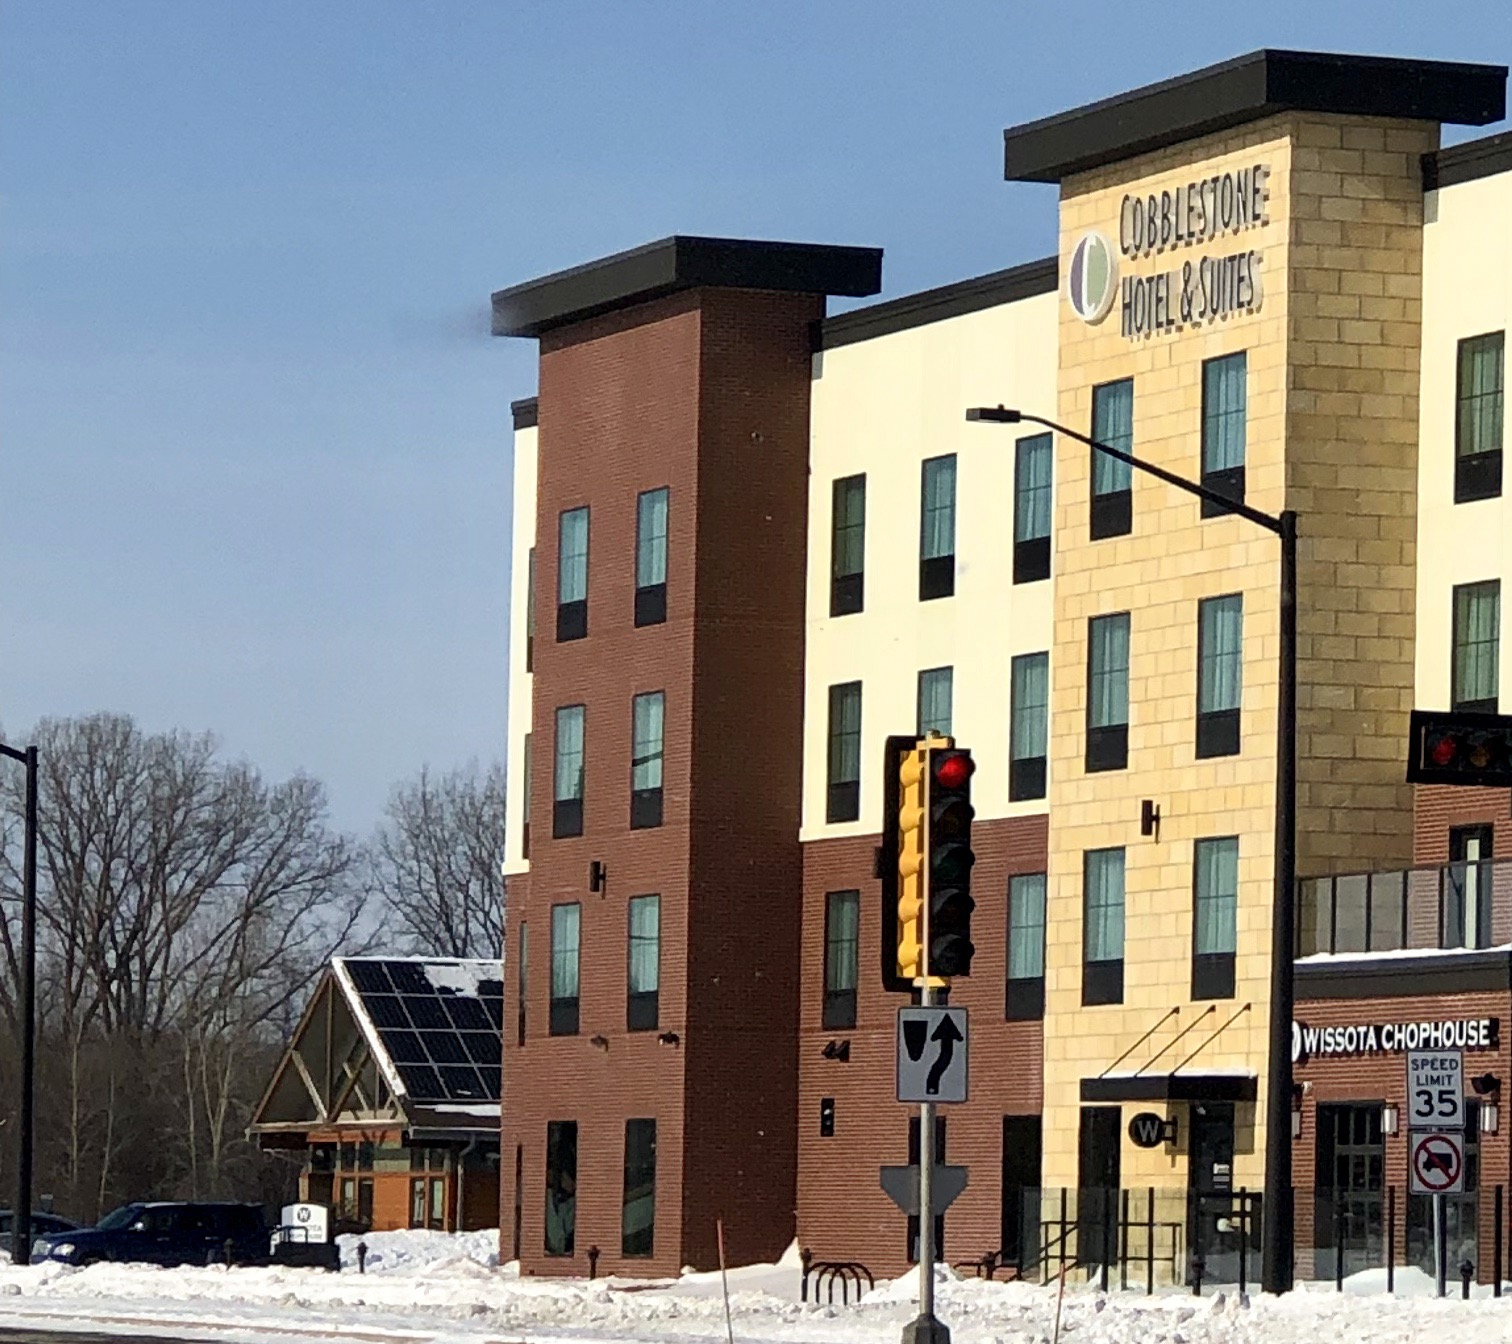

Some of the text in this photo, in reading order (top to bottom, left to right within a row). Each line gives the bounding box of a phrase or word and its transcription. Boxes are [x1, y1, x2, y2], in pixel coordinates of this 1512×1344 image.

[1119, 164, 1269, 256] COBBLESTONE
[1121, 250, 1260, 339] HOTEL & SUITES
[1303, 1019, 1491, 1053] WISSOTA CHOPHOUSE
[1411, 1058, 1459, 1072] SPEED
[1416, 1074, 1454, 1087] LIMIT
[1415, 1089, 1458, 1118] 35
[1136, 1120, 1160, 1143] W
